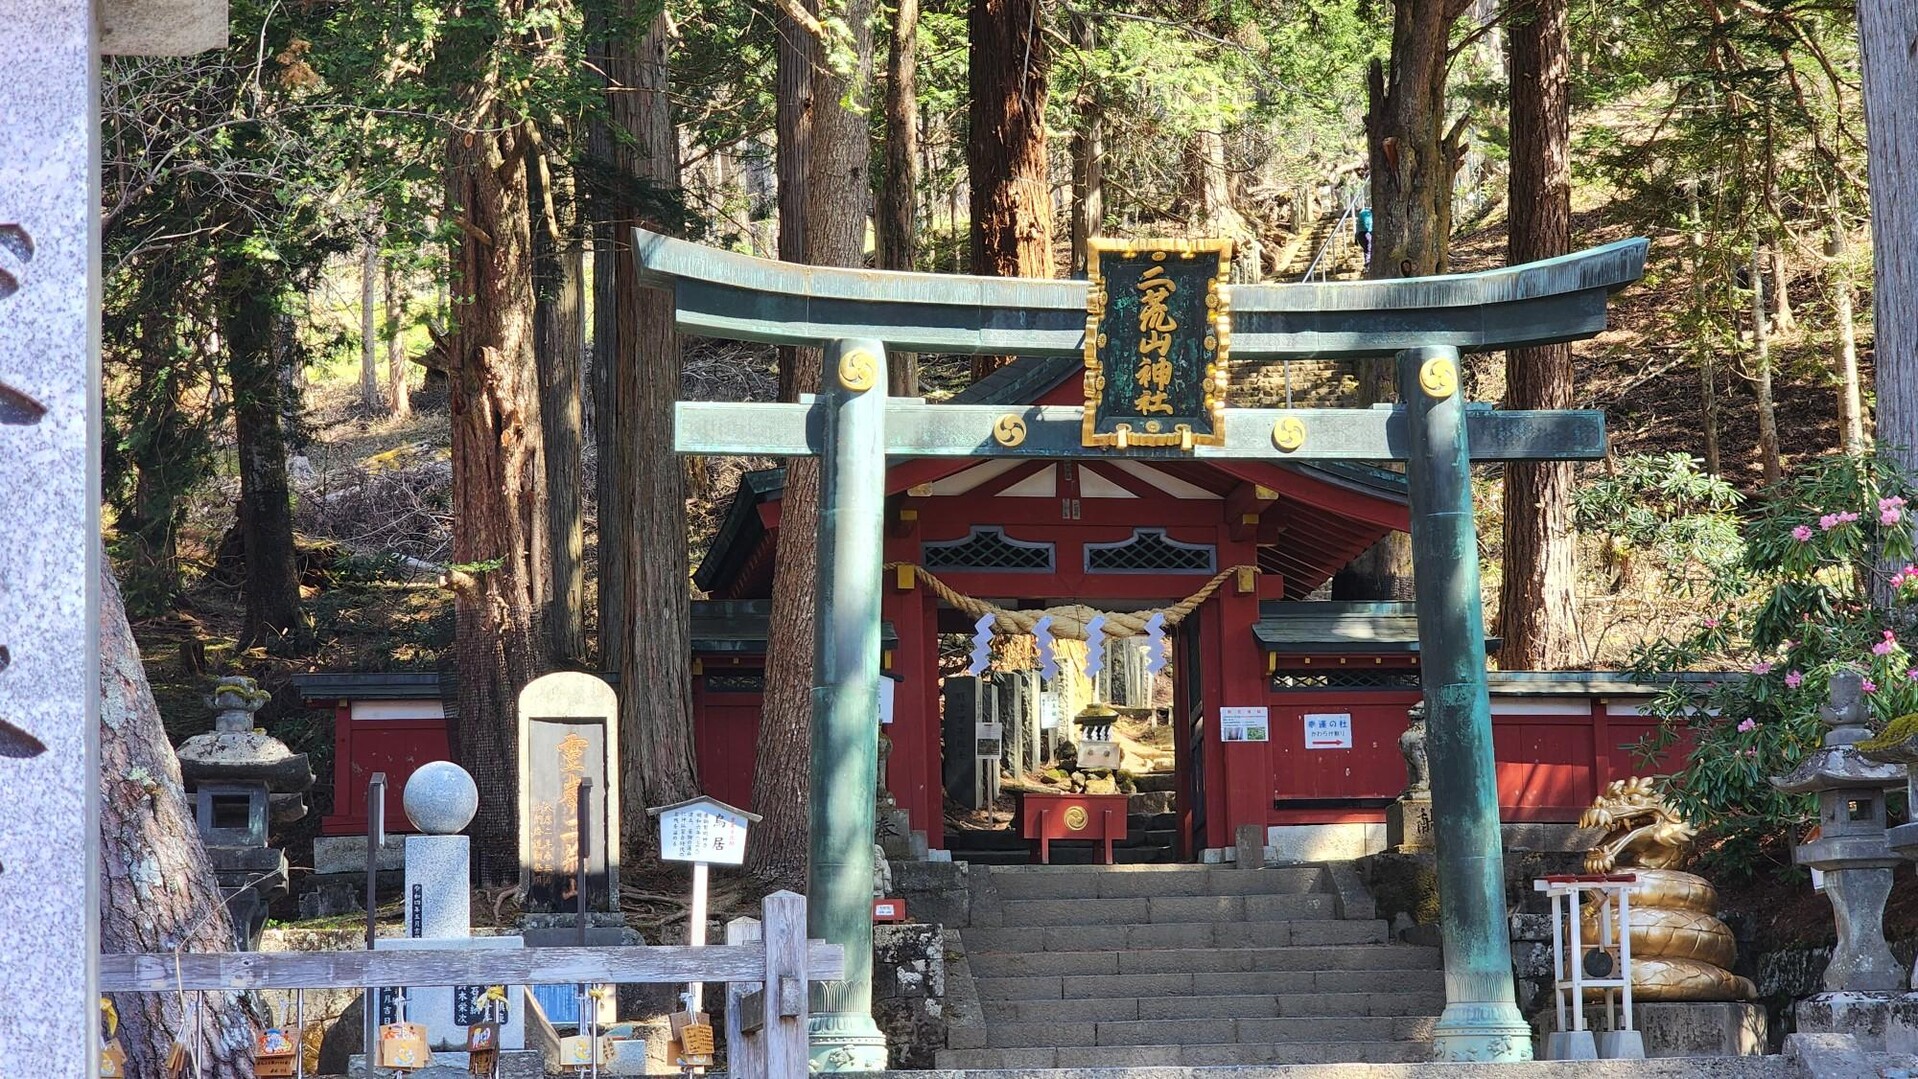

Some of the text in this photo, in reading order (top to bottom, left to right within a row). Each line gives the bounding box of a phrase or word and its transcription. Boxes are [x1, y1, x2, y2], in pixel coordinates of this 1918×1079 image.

[1134, 265, 1178, 416] 二荒山神社
[713, 813, 726, 851] 鳥居
